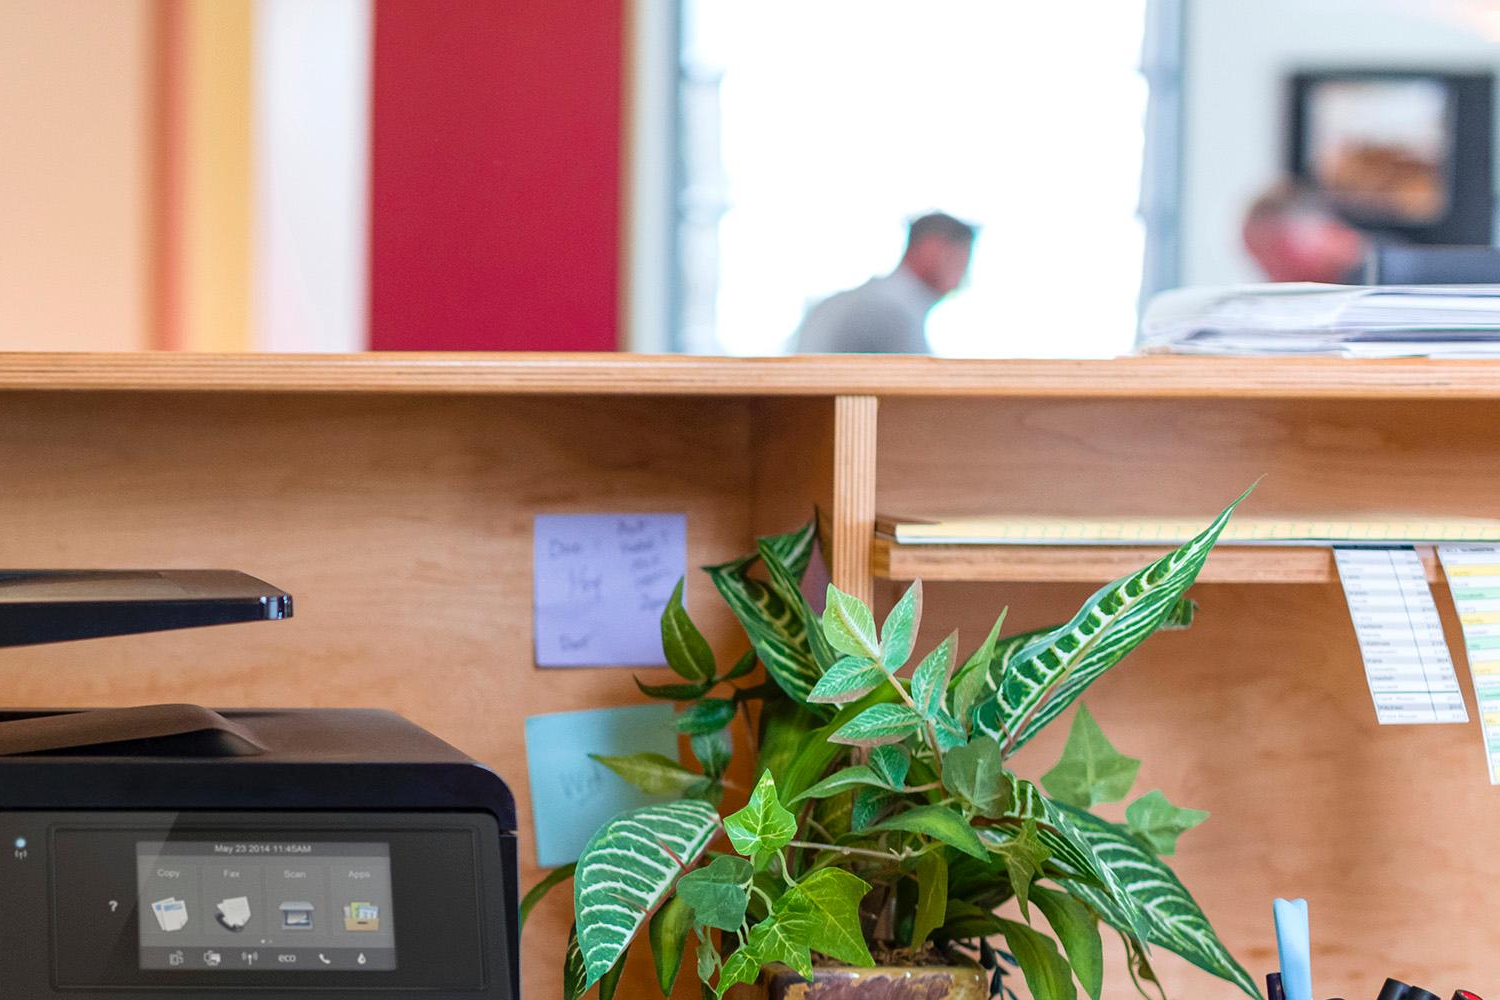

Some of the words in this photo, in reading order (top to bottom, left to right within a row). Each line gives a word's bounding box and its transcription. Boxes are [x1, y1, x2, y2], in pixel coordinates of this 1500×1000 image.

[214, 844, 233, 855] May
[235, 844, 247, 853] 23
[248, 844, 271, 853] 2014
[273, 844, 312, 854] 11:45AM
[157, 868, 181, 879] Copy
[223, 869, 240, 879] Fax
[284, 869, 307, 879] Scan
[348, 869, 371, 880] Apps
[278, 954, 297, 963] eco
